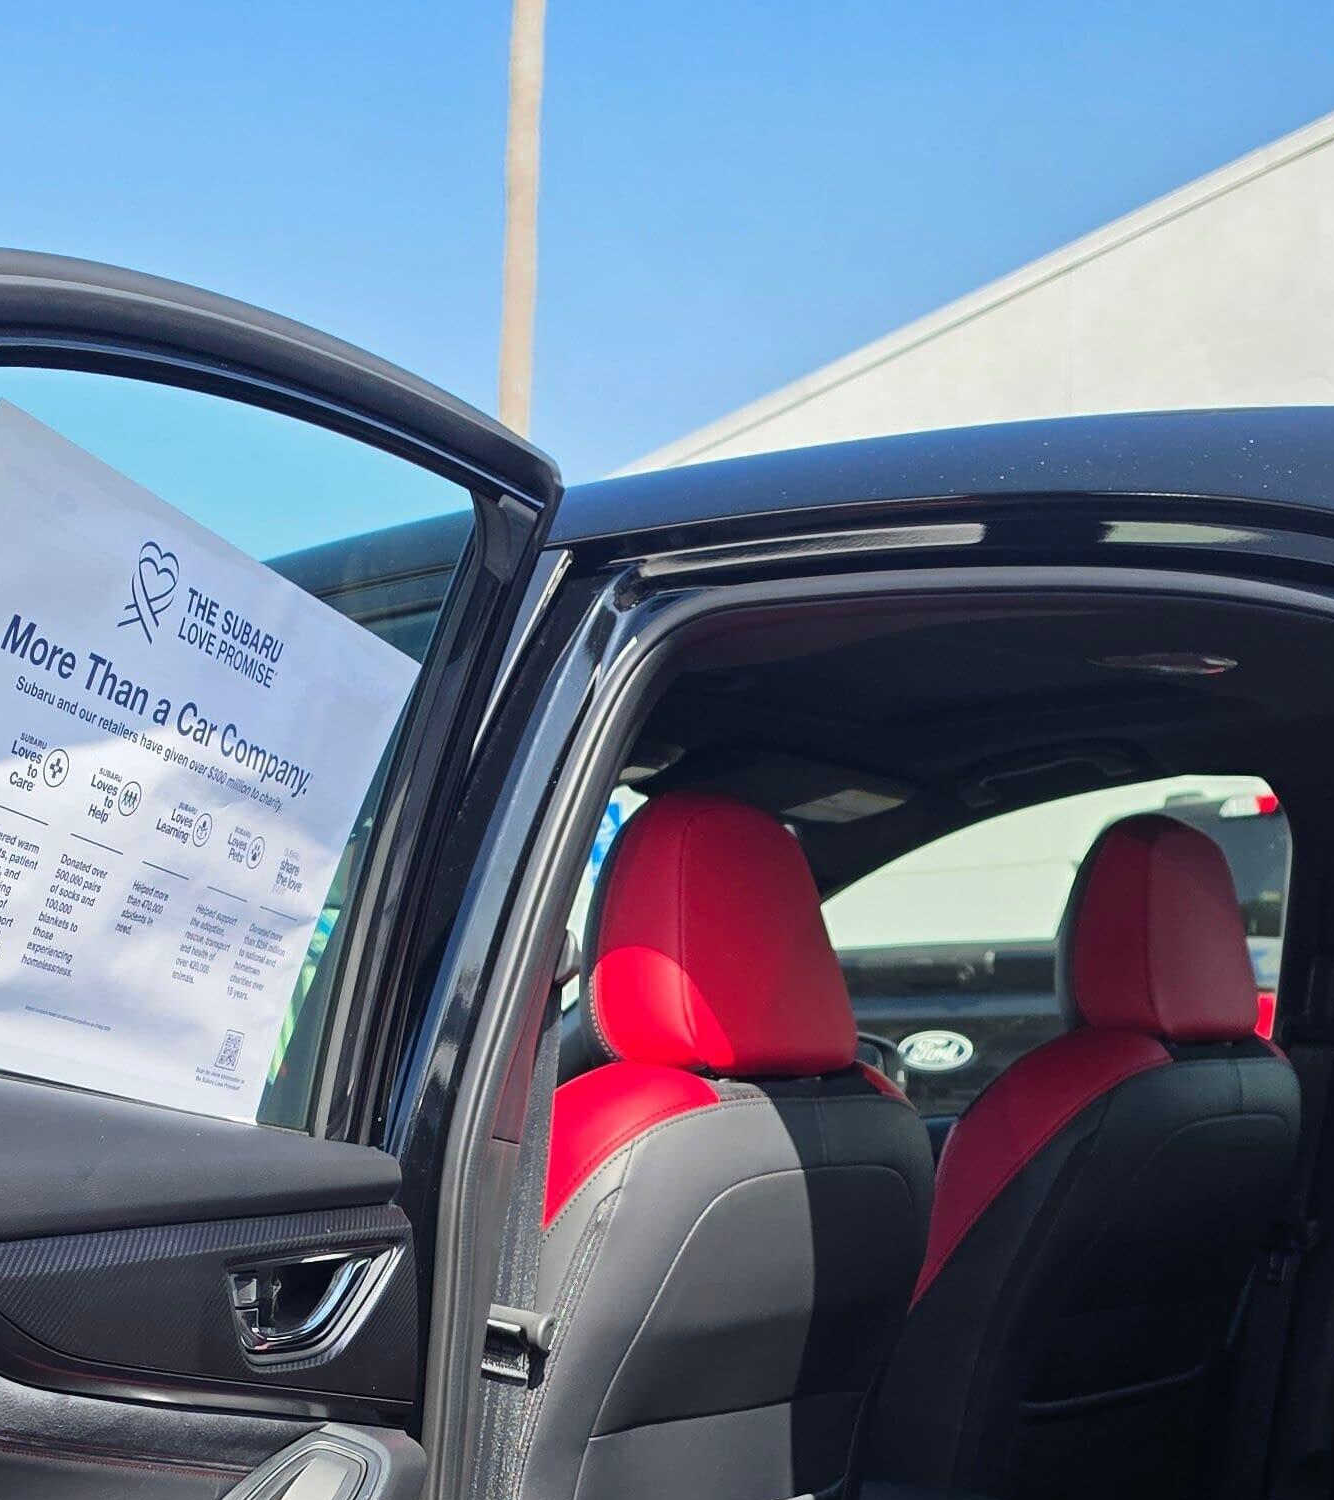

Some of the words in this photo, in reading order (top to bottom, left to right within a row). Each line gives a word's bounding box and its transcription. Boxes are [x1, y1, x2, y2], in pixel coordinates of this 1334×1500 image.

[187, 586, 219, 627] THE
[221, 610, 283, 663] SUBARU
[177, 616, 216, 655] LOVE
[215, 639, 274, 688] PROMISE
[0, 613, 76, 679] More
[85, 651, 148, 715] Than
[152, 698, 171, 726] a
[176, 701, 217, 746] Car
[220, 723, 310, 797] Company.
[15, 675, 55, 705] Subaru
[56, 697, 78, 715] and
[78, 708, 97, 724] our
[97, 716, 138, 743] retailers
[139, 732, 163, 754] have
[162, 747, 188, 767] given
[188, 759, 208, 775] over
[207, 765, 227, 784] $300
[225, 777, 251, 795] million
[250, 787, 259, 799] to
[258, 792, 283, 812] charity.
[19, 732, 47, 749] SUBARU
[11, 739, 42, 764] Loves
[26, 763, 37, 778] to
[98, 767, 122, 782] SUBARU
[9, 771, 35, 791] Care
[90, 773, 118, 796] Loves
[103, 795, 113, 808] to
[178, 801, 197, 815] SUBARU
[87, 803, 110, 823] Help
[170, 808, 193, 828] Loves
[155, 817, 189, 844] Learning
[17, 839, 39, 854] warm
[227, 832, 247, 851] Loves
[8, 853, 38, 870] patient
[227, 847, 244, 863] Pets
[3, 868, 21, 880] and
[60, 853, 92, 873] Donated
[91, 867, 107, 879] over
[279, 858, 299, 876] share
[54, 868, 83, 886] 500,000
[81, 880, 101, 893] pairs
[275, 871, 290, 887] the
[286, 875, 302, 892] love
[49, 884, 59, 893] of
[58, 887, 80, 901] socks
[80, 895, 96, 906] and
[131, 879, 155, 895] Helped
[152, 889, 168, 901] more
[44, 897, 72, 914] 100,000
[126, 894, 141, 907] than
[38, 911, 69, 929] blankets
[69, 922, 78, 932] to
[146, 916, 153, 926] in
[189, 916, 200, 927] the
[195, 903, 217, 918] Helped
[215, 912, 237, 926] support
[32, 925, 53, 940] those
[248, 922, 271, 937] Donated
[26, 941, 72, 964] experiencing
[179, 943, 192, 953] and
[190, 945, 208, 959] health
[208, 952, 216, 961] of
[204, 936, 230, 952] transport
[238, 947, 245, 957] to
[20, 953, 71, 977] homelessness.
[175, 957, 189, 967] over
